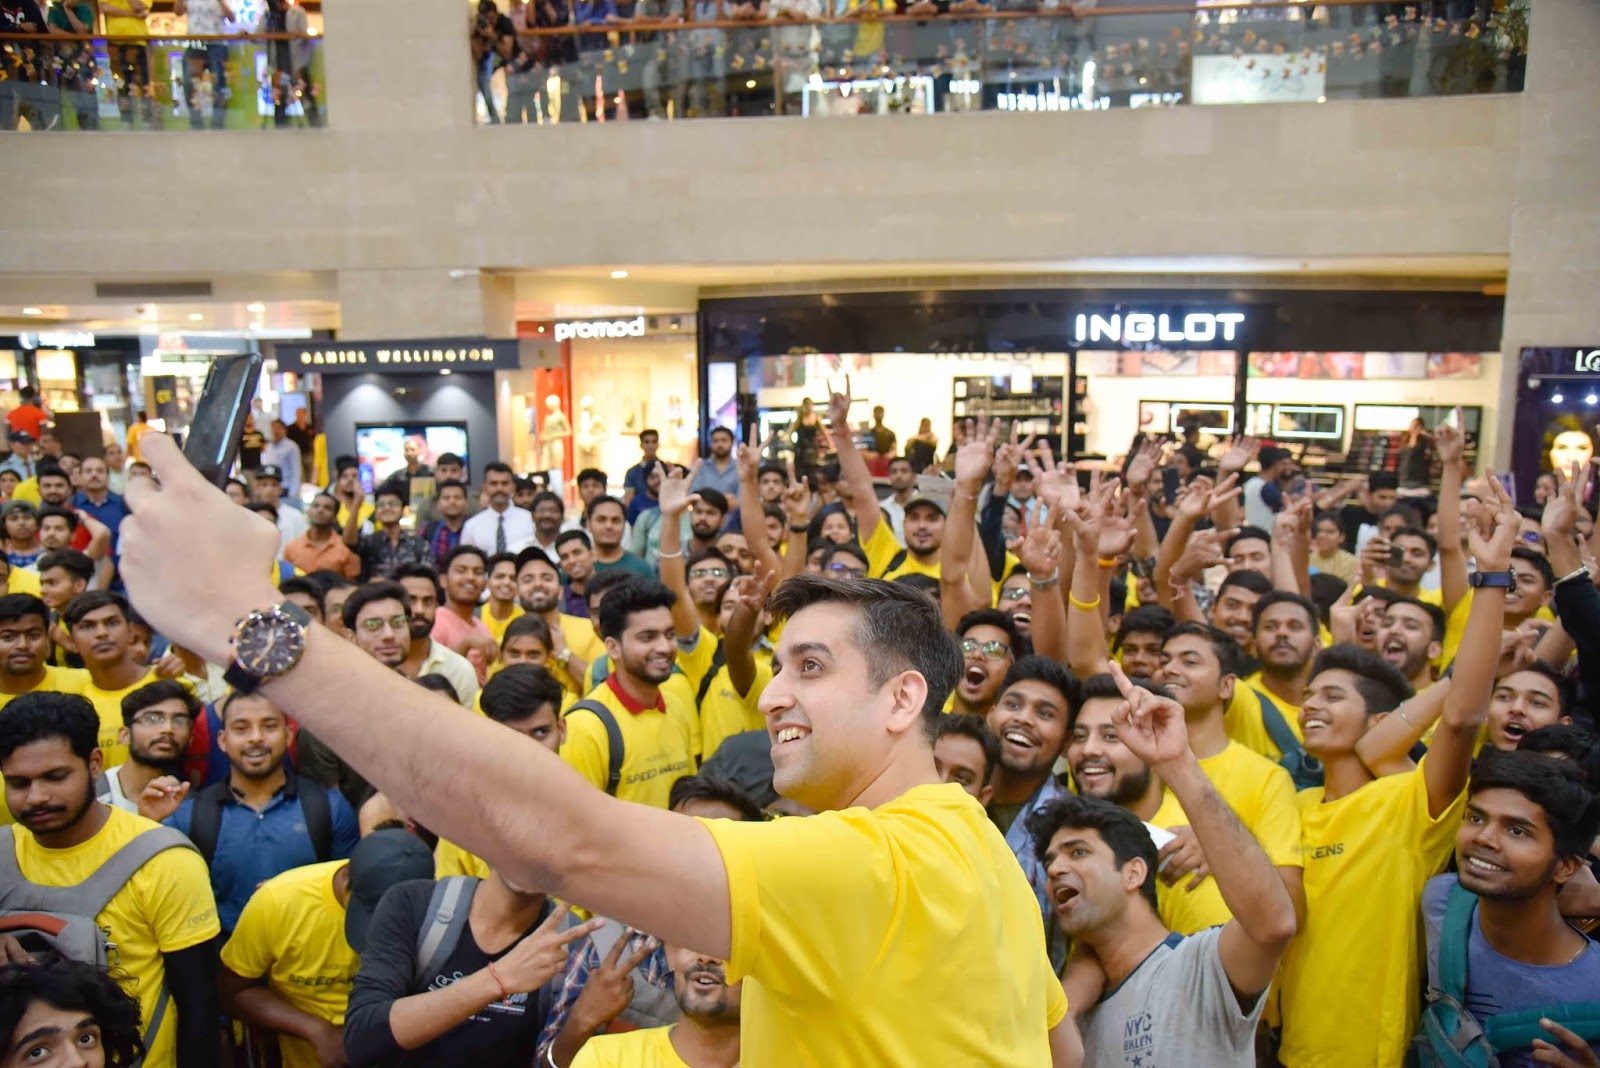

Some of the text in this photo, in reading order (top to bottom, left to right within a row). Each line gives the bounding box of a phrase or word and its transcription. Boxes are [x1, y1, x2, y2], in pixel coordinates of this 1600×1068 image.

[554, 316, 645, 342] promod
[1075, 313, 1245, 342] INGLOT
[301, 349, 494, 364] DANIEL WELLINGTON
[1124, 1013, 1152, 1038] NYC
[1124, 1034, 1152, 1051] BKLYN
